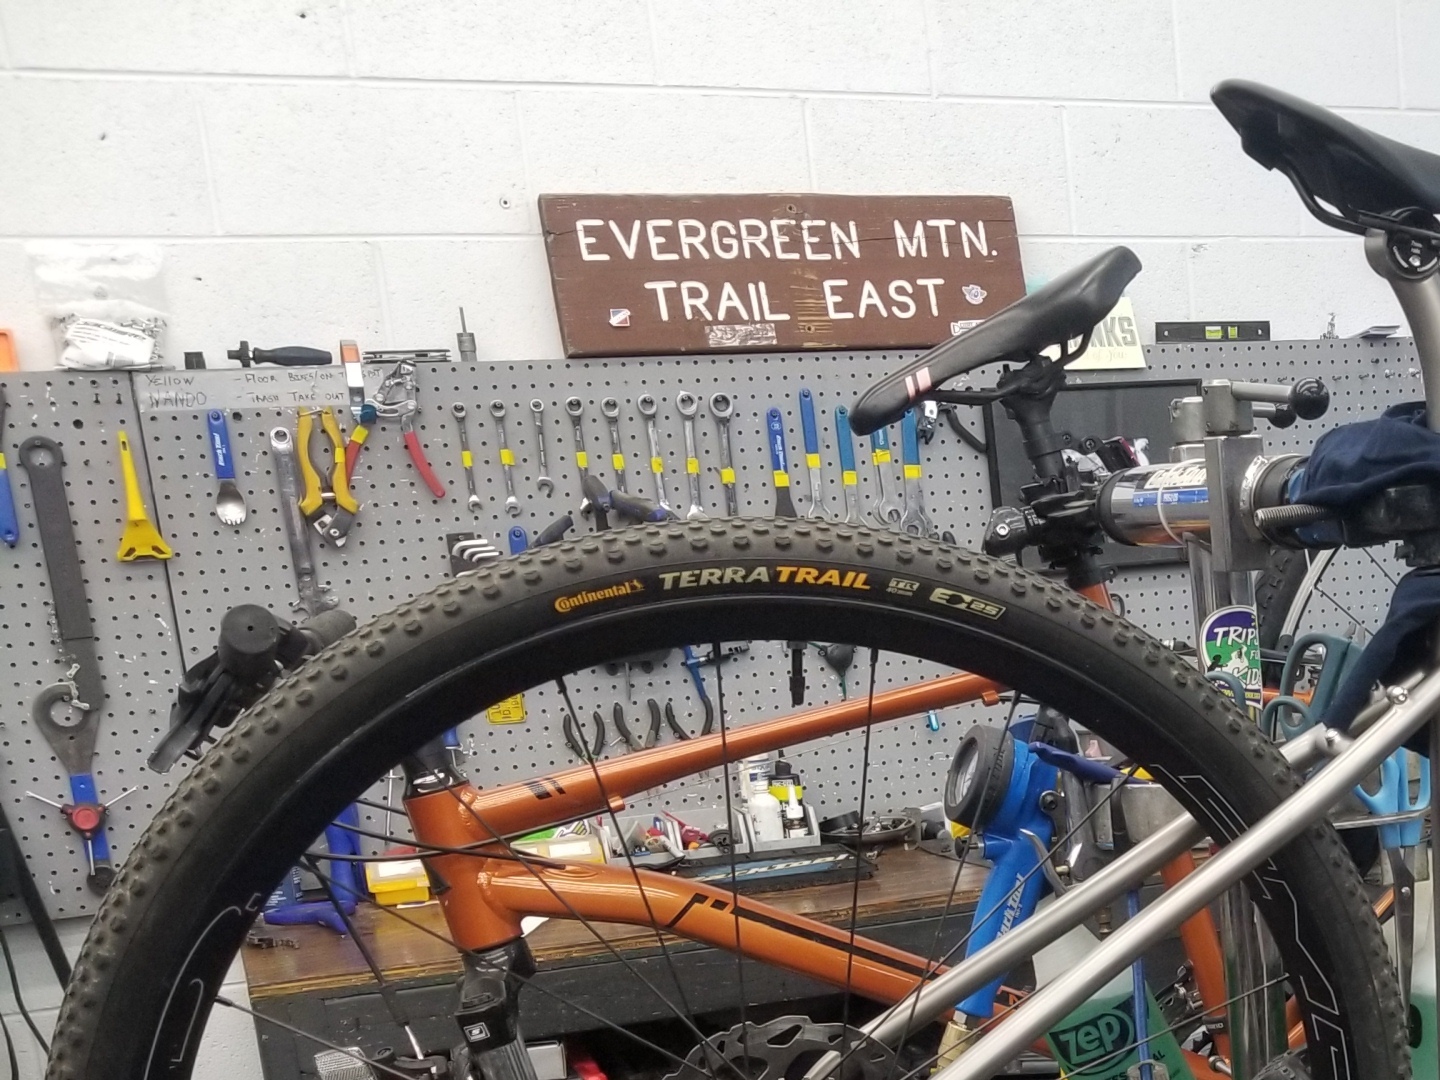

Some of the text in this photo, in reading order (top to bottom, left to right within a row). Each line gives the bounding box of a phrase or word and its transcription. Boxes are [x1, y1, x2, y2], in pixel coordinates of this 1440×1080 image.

[575, 217, 999, 261] EVERGREEN MTN.
[643, 277, 945, 322] TRAIL EAST
[324, 391, 345, 401] OUT
[658, 565, 872, 591] TERRA TRAIL
[554, 582, 633, 614] Continental
